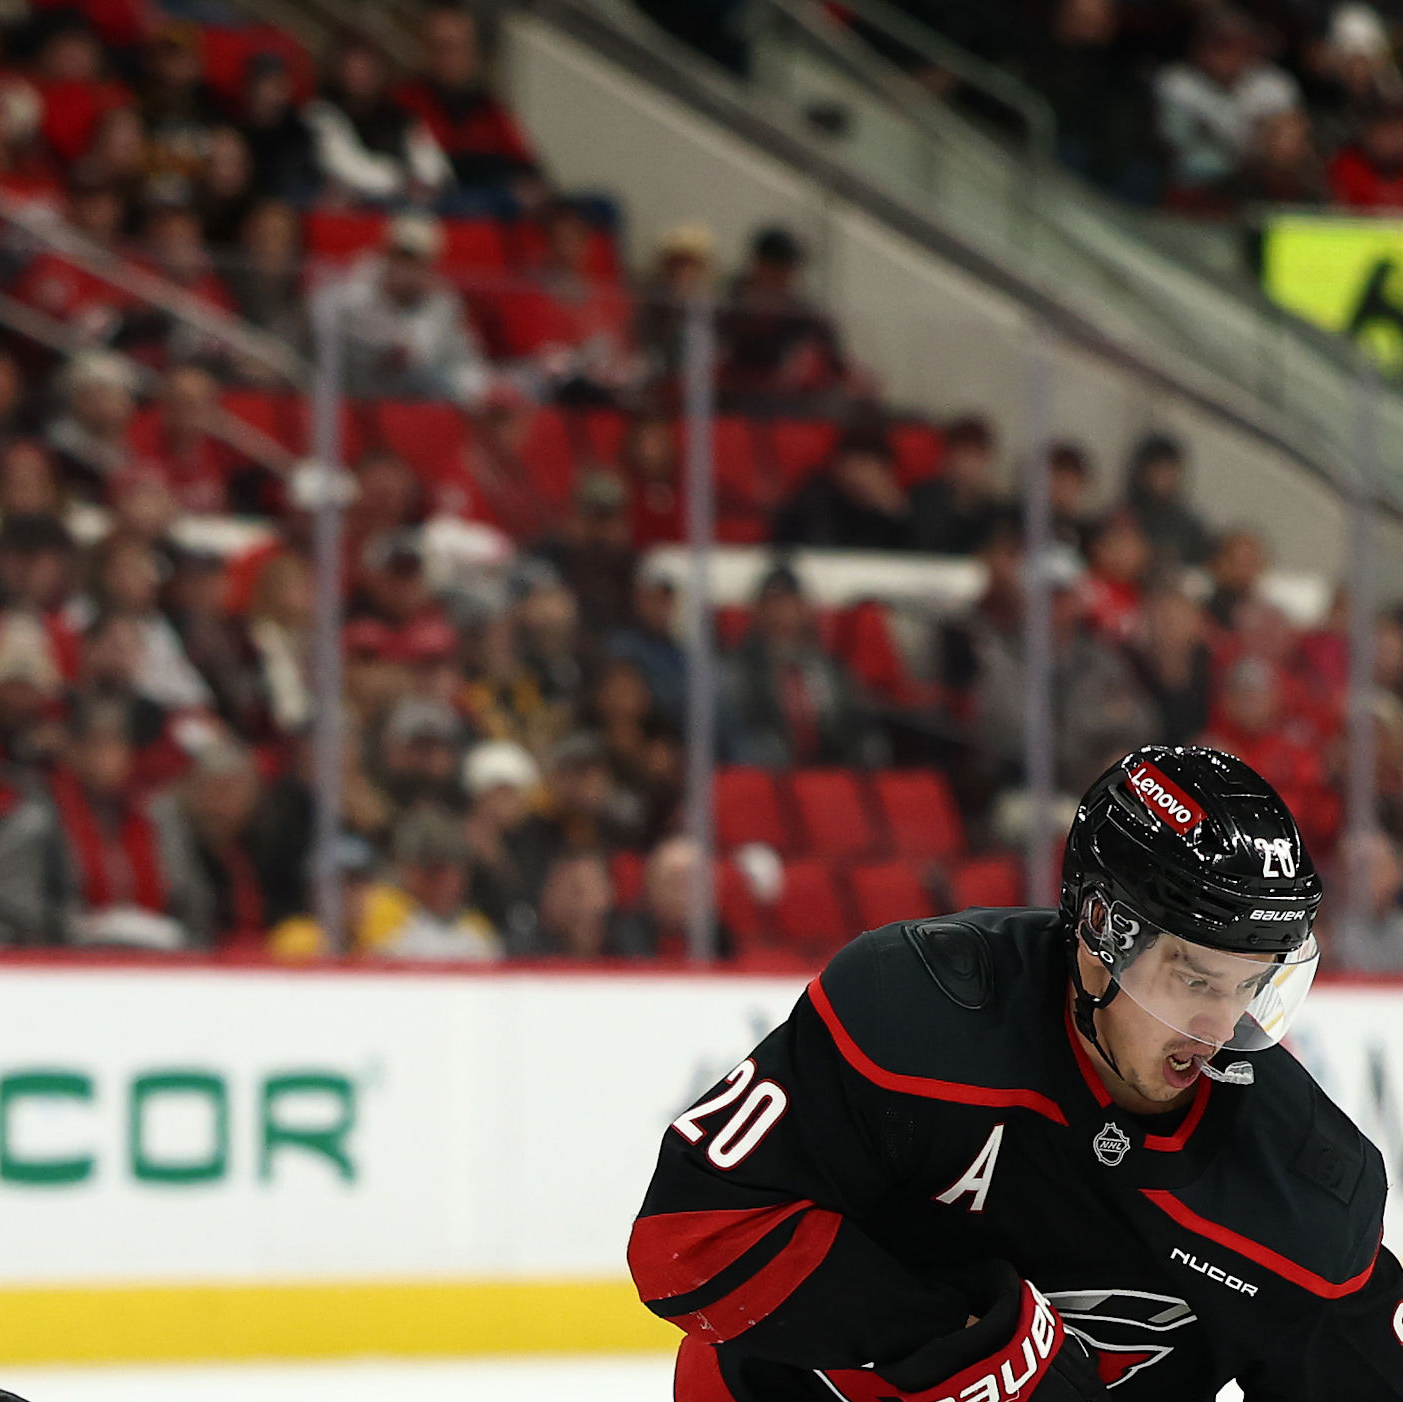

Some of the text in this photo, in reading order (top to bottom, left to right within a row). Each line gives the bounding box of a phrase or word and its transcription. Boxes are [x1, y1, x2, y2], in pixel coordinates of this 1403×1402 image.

[1130, 767, 1192, 824] Lenovo
[1253, 837, 1296, 878] 20
[671, 1058, 789, 1171] 20
[935, 1122, 1004, 1214] A
[1099, 1139, 1122, 1151] NHL
[1170, 1248, 1259, 1298] NUCOR
